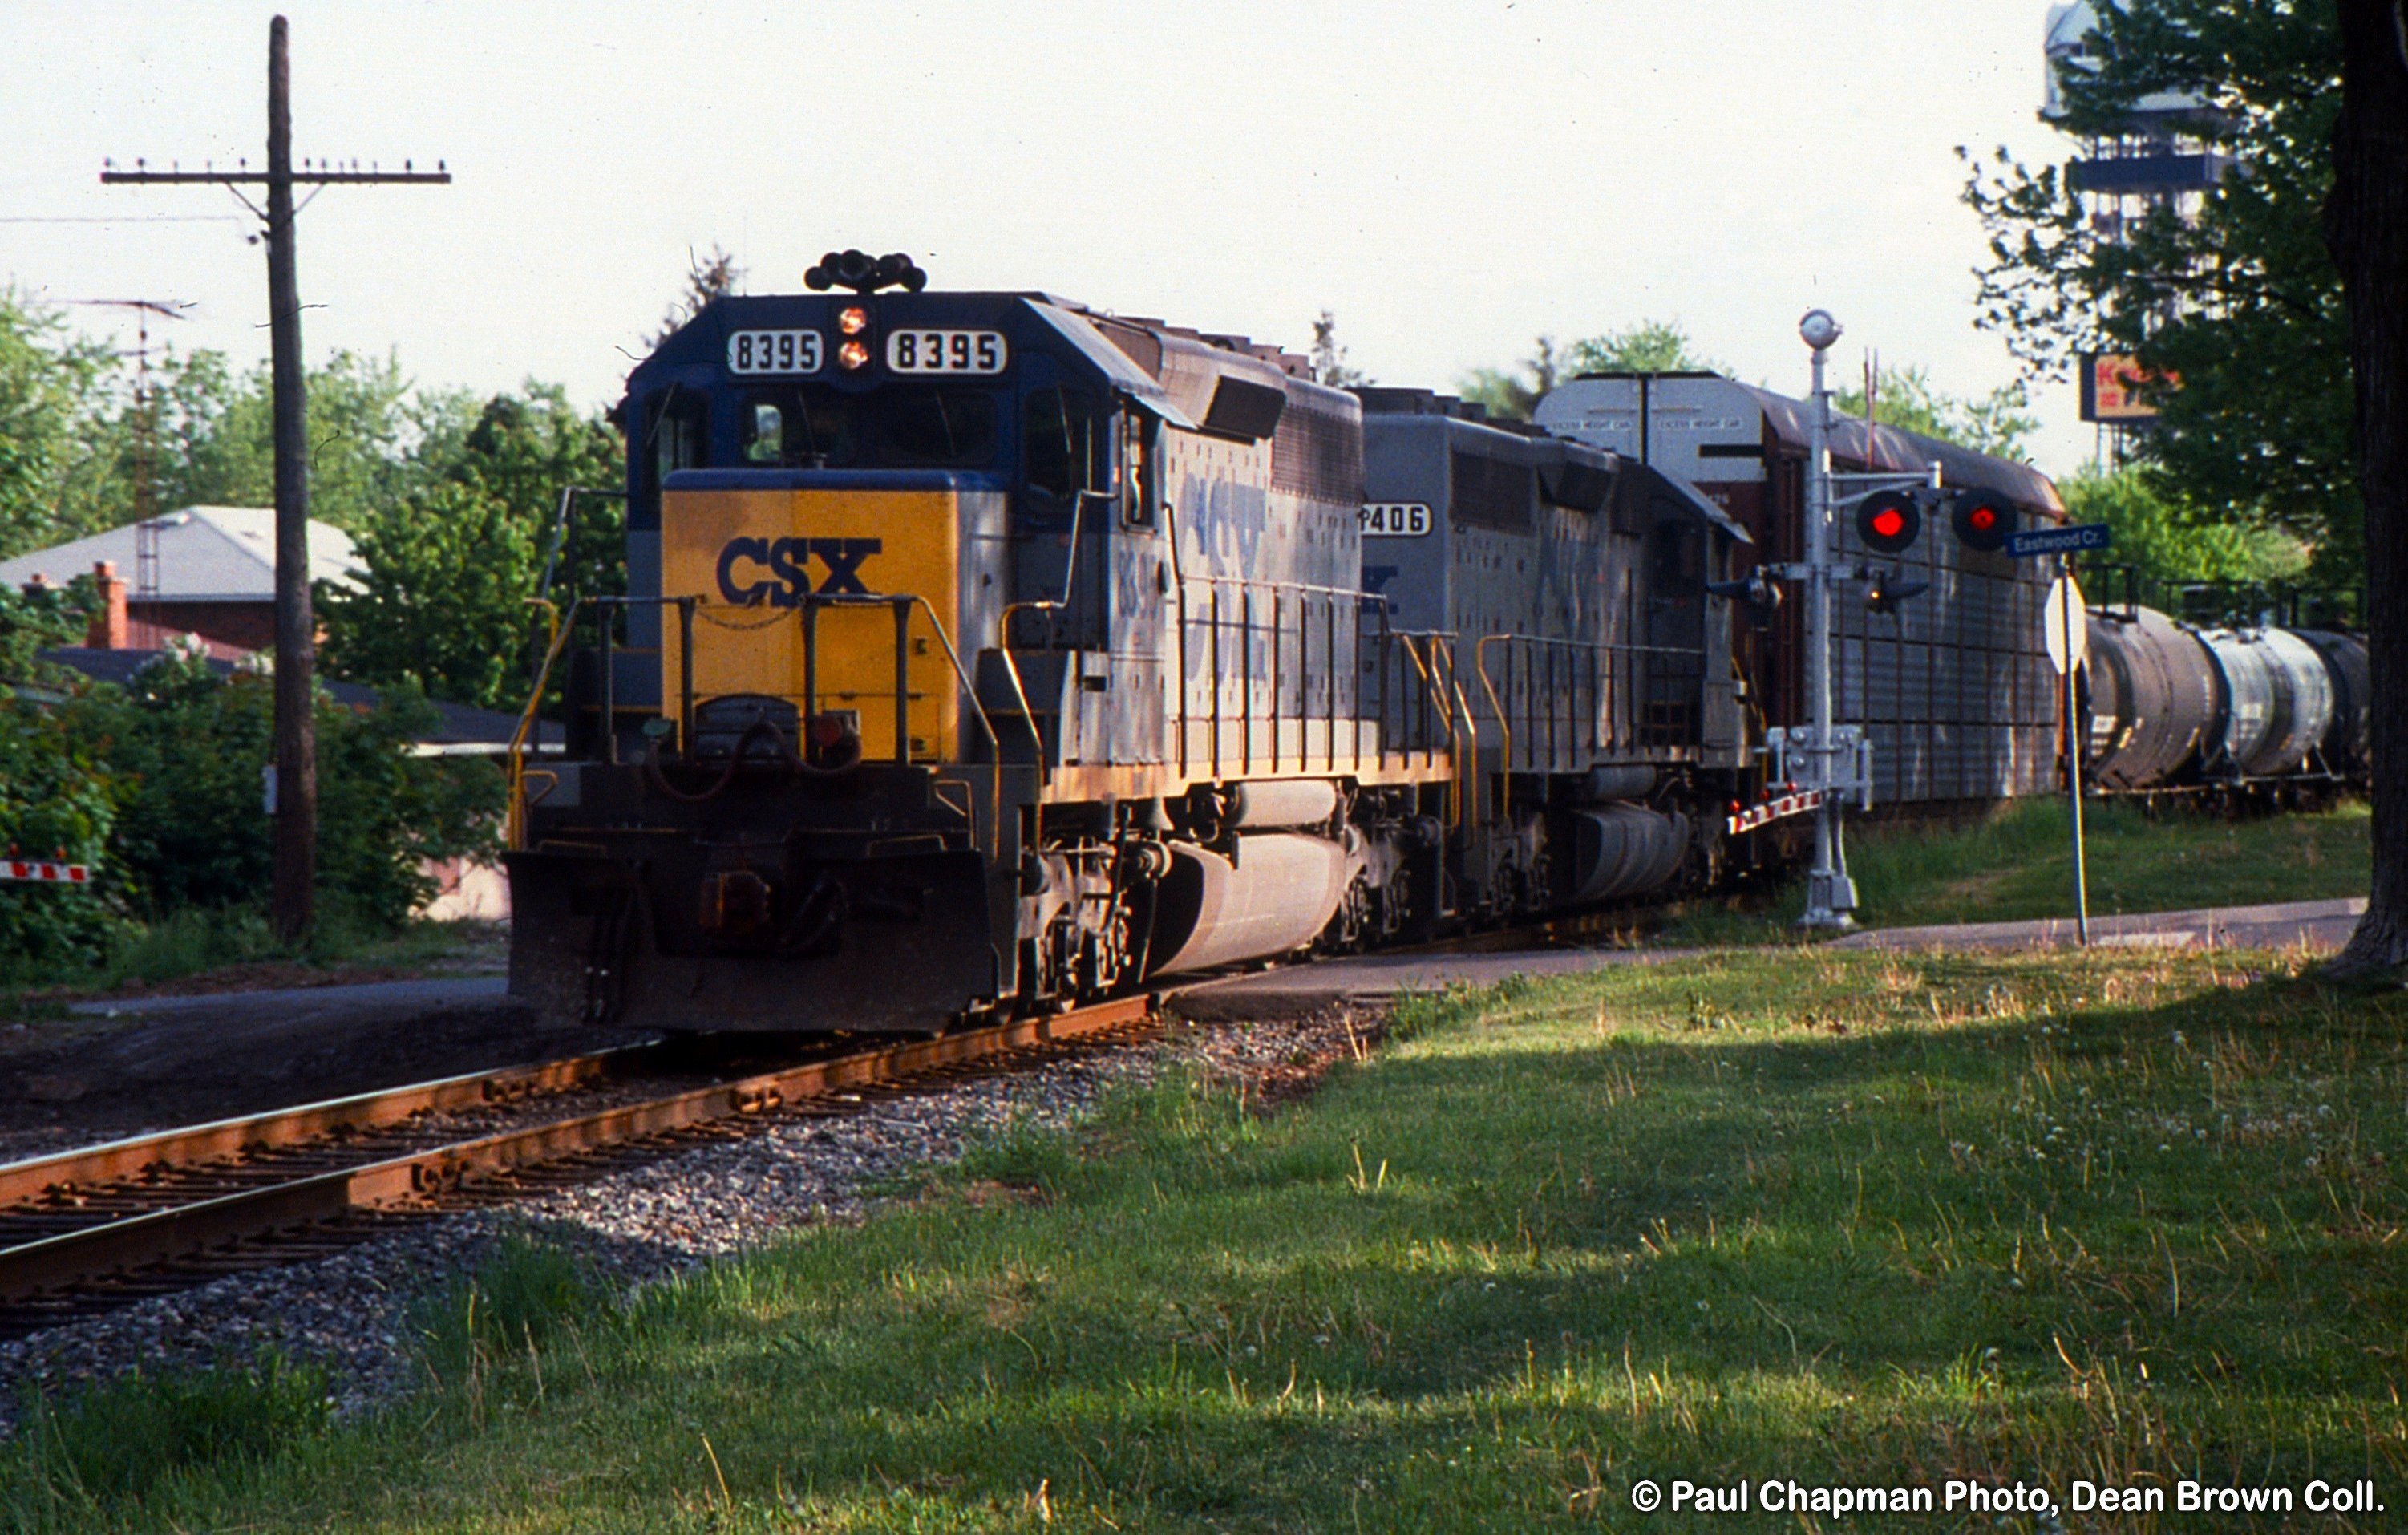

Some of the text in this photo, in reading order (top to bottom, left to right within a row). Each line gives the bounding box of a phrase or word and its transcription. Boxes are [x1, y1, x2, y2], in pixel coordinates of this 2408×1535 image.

[737, 333, 816, 371] 8395
[897, 333, 998, 370] 8395
[2013, 532, 2080, 553] Eastwood
[716, 536, 882, 607] CSX
